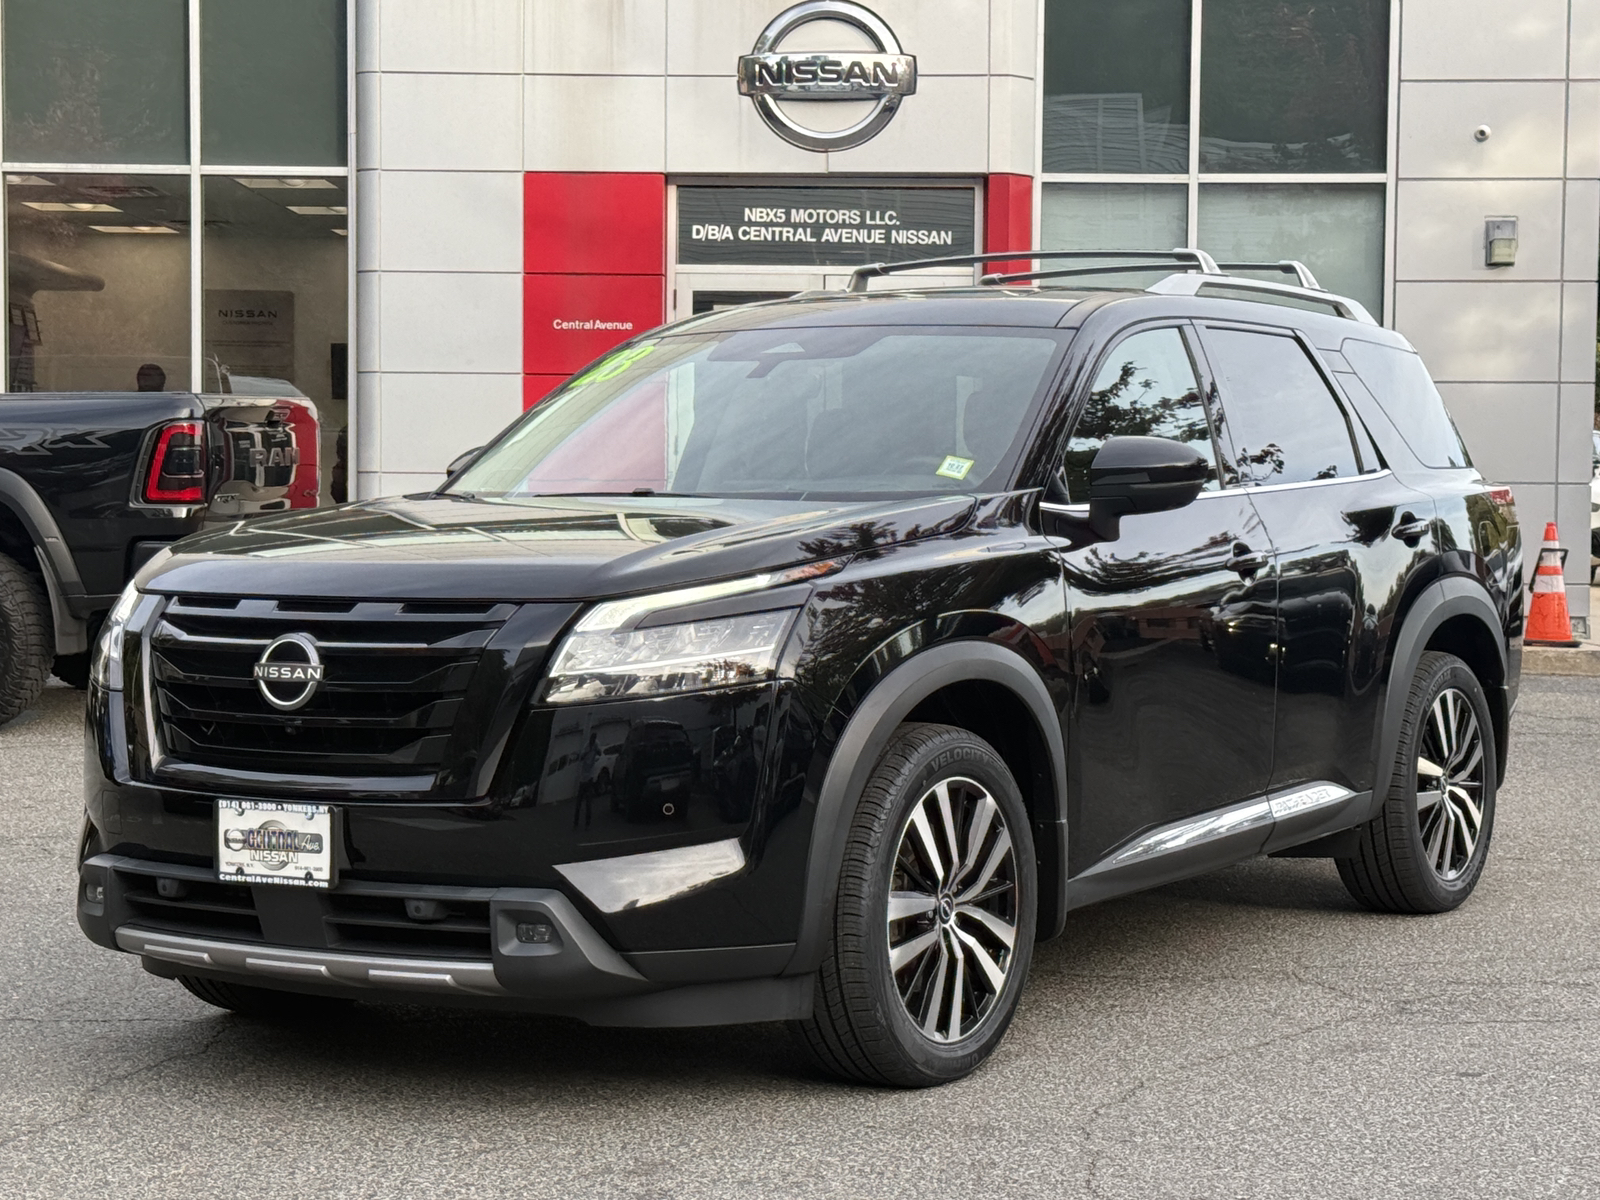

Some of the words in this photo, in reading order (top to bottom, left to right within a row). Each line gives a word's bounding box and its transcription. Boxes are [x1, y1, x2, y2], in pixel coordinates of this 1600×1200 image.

[755, 60, 899, 87] NISSAN
[744, 207, 786, 222] NBX5
[790, 208, 861, 224] MOTORS
[865, 210, 900, 225] LLC.
[691, 224, 734, 242] D/B/A
[737, 226, 817, 242] CENTRAL
[820, 228, 886, 243] AVENUE
[890, 229, 953, 245] NISSAN
[218, 309, 278, 319] NISSAN
[553, 319, 593, 330] Central
[594, 319, 633, 330] Avenue
[249, 447, 300, 467] RAM
[254, 666, 321, 679] NISSAN
[930, 748, 989, 772] VELOCITY
[249, 849, 299, 864] NISSAN
[219, 873, 329, 888] CentralAveNissan.com
